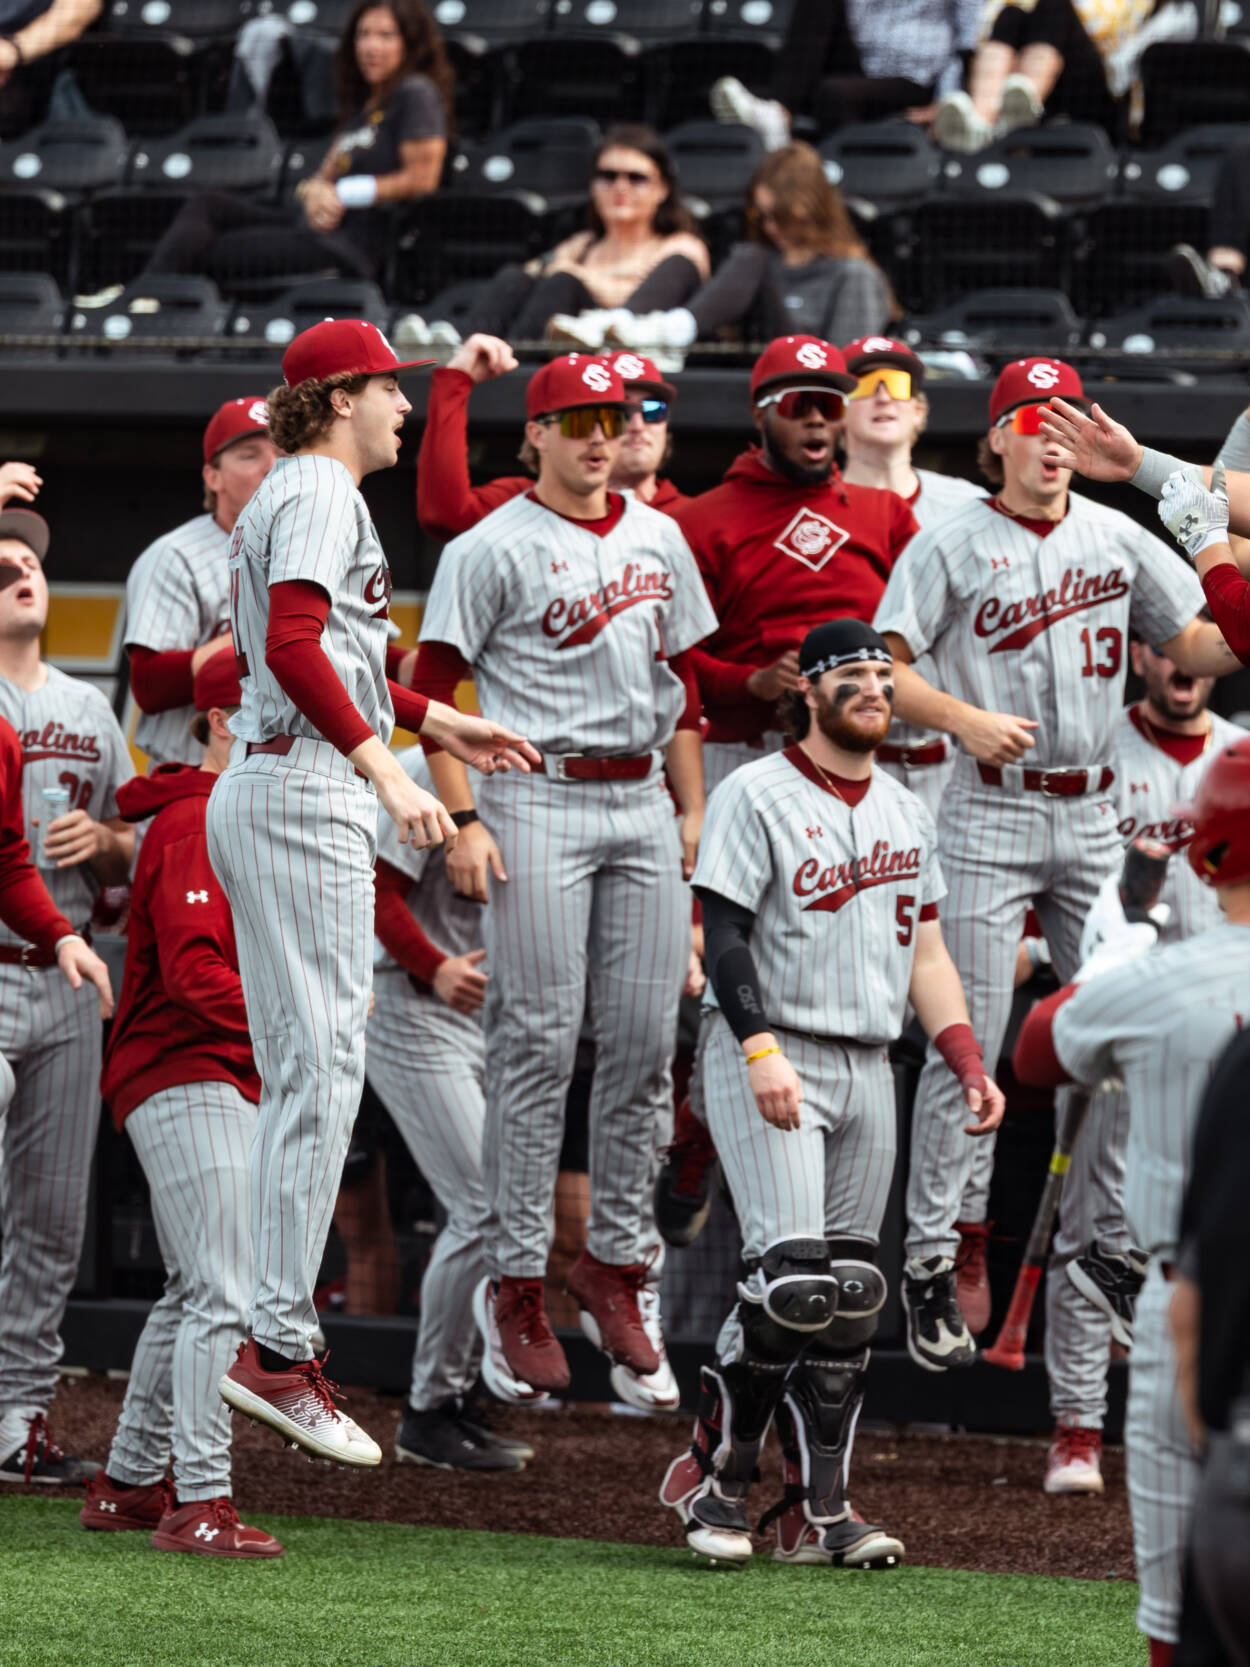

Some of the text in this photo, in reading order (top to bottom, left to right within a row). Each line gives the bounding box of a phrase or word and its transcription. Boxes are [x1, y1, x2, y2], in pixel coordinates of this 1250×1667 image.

[974, 567, 1127, 638] Carolina
[1080, 627, 1122, 678] 13
[18, 721, 97, 752] olina
[792, 840, 920, 896] Carolina
[895, 894, 916, 948] 5
